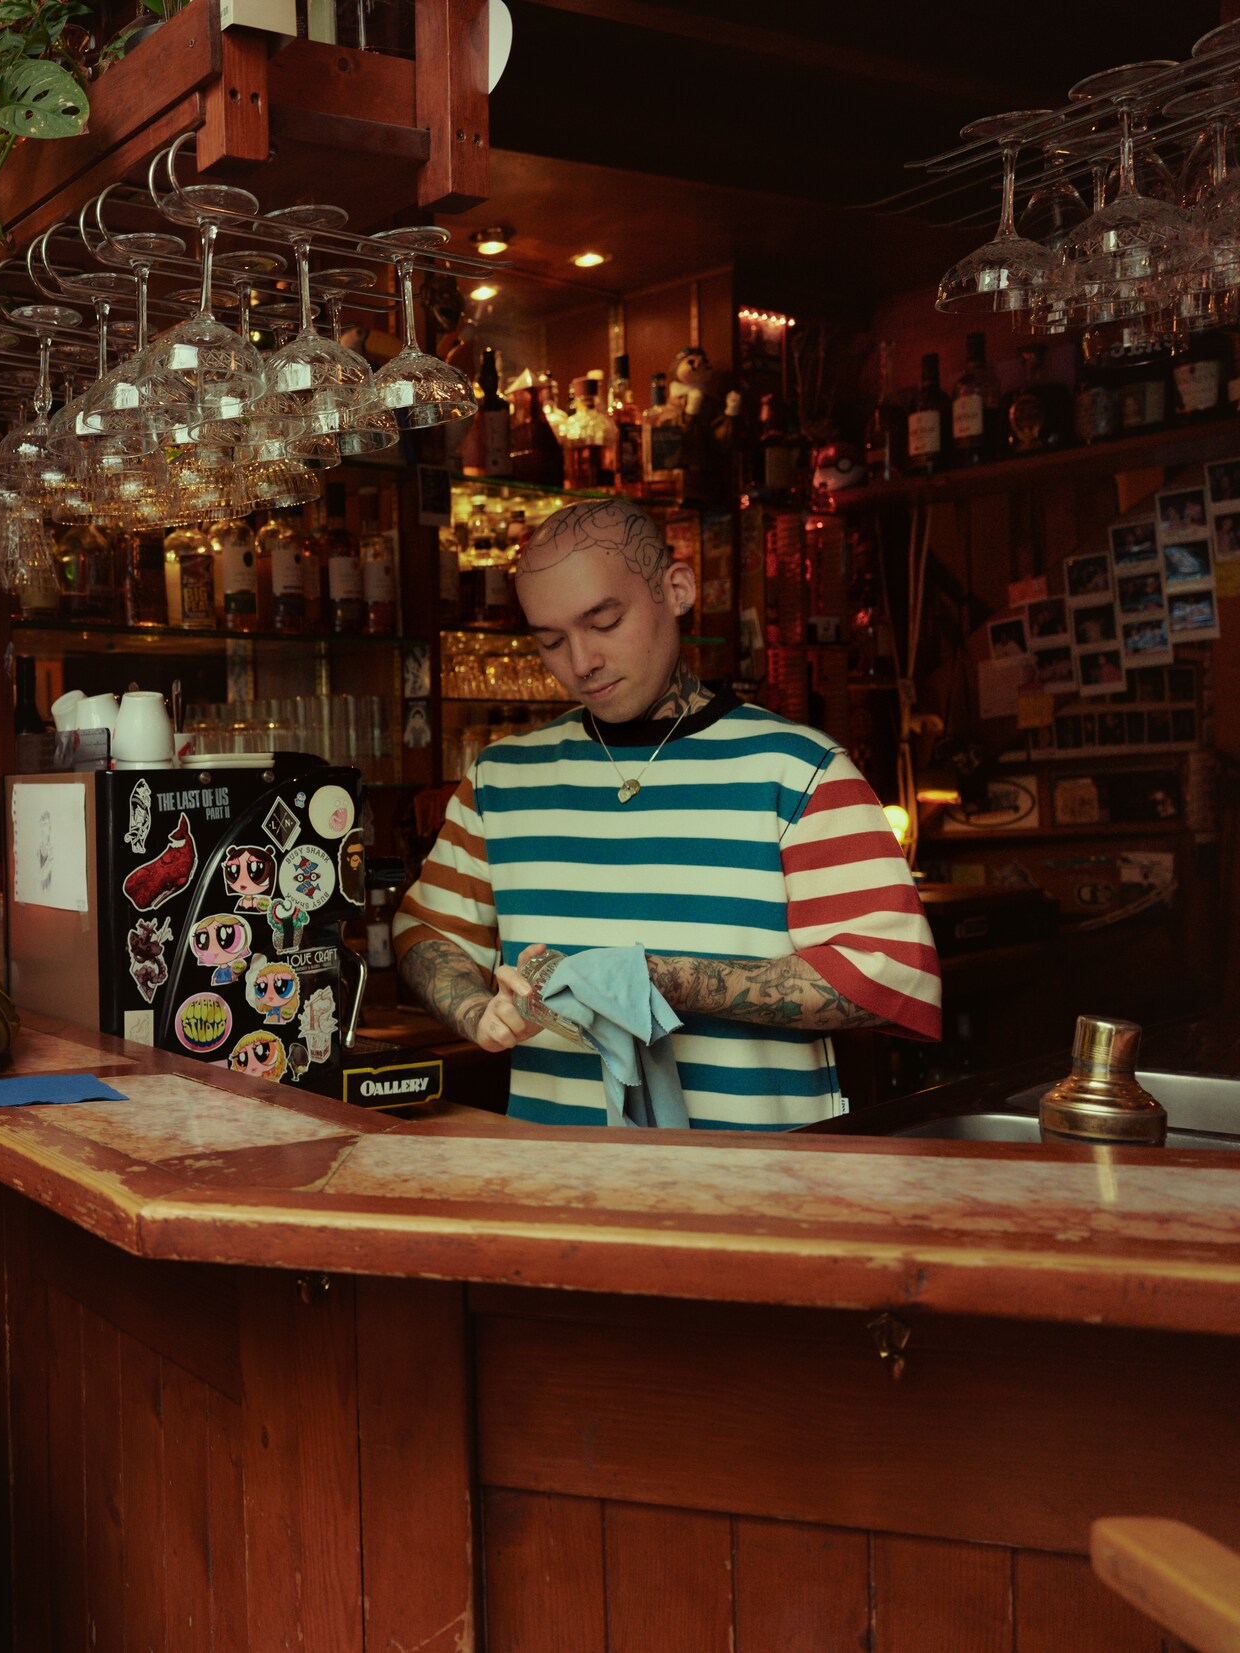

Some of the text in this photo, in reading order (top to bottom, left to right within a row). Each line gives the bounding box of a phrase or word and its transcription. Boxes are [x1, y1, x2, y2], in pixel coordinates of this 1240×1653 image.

[156, 786, 230, 812] THE LAST OF US
[206, 806, 231, 821] PART II
[285, 846, 331, 865] BUSY SHARK
[312, 891, 331, 909] BUSY
[314, 948, 338, 964] CRAFT
[183, 1018, 226, 1042] STUDIO
